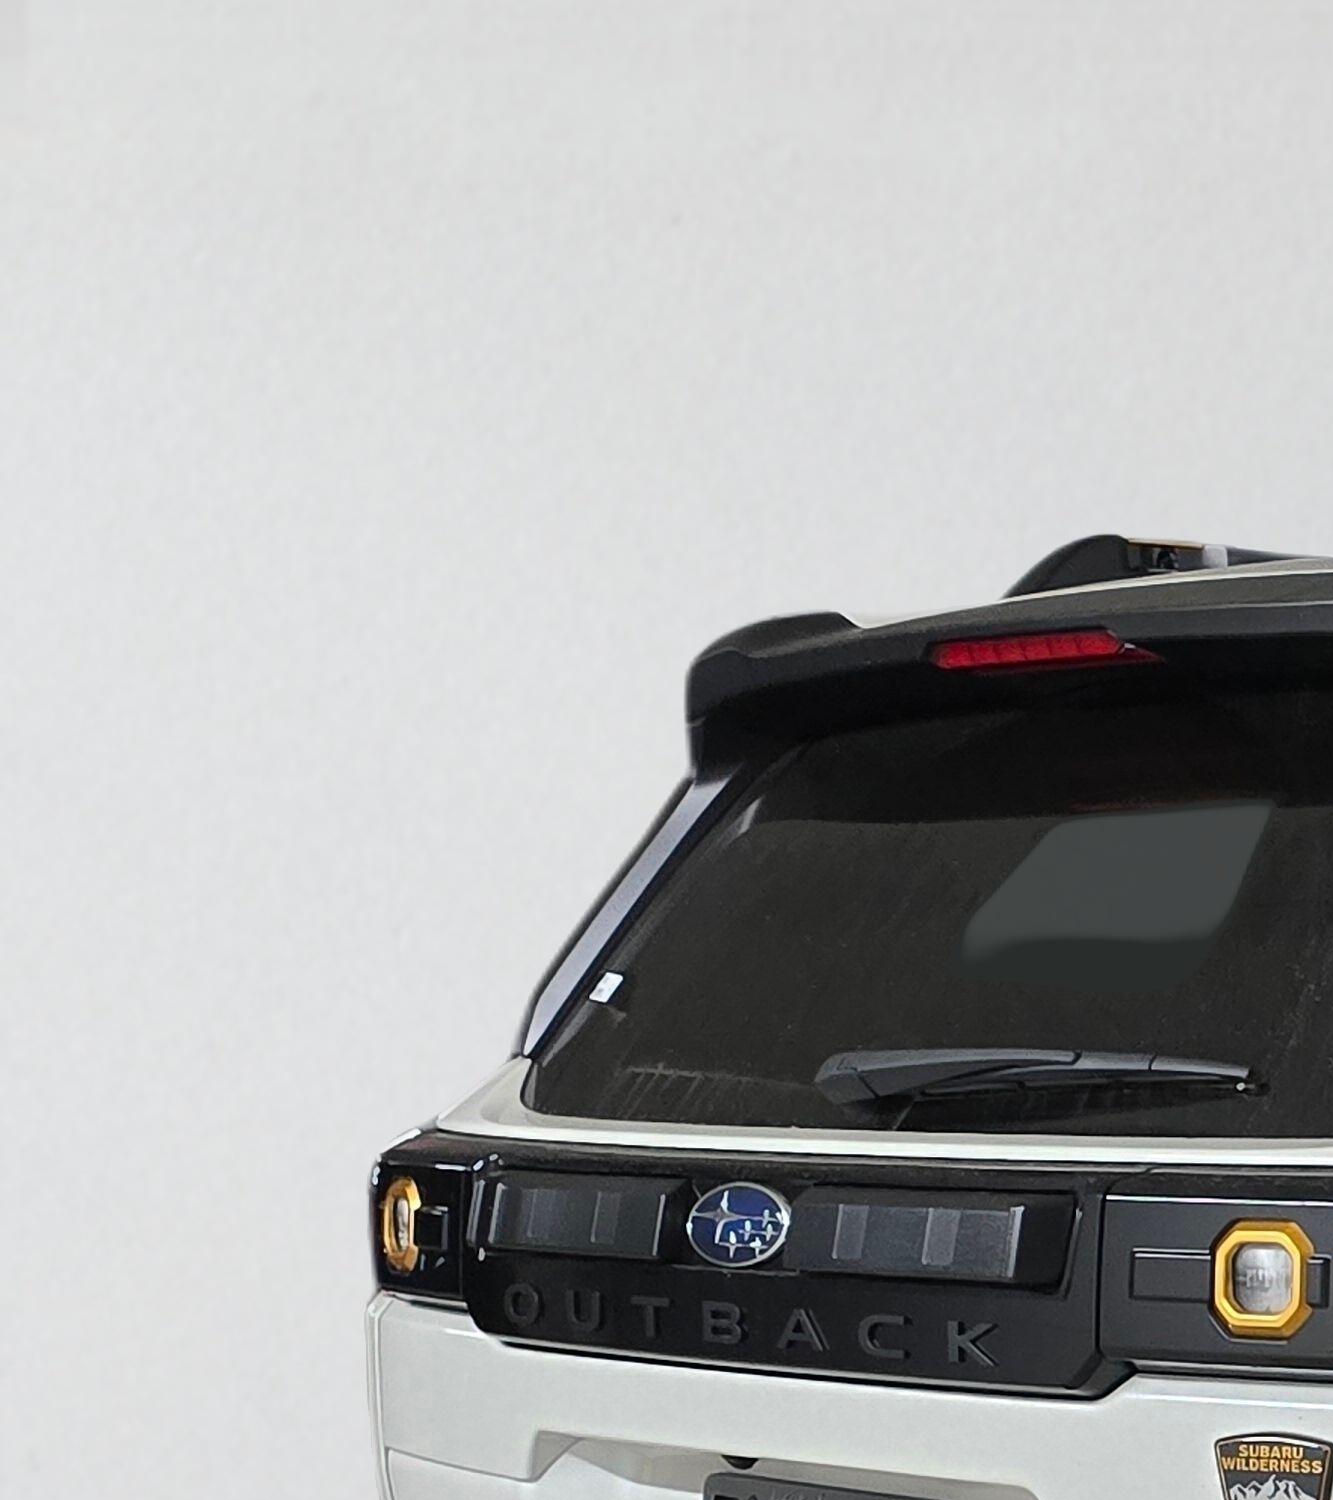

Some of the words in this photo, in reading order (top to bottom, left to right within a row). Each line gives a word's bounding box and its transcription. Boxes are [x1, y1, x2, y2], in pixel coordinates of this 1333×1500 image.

[503, 1281, 1001, 1368] OUTBACK
[1238, 1444, 1304, 1459] SUBARU
[1222, 1456, 1323, 1474] WILDERNESS
